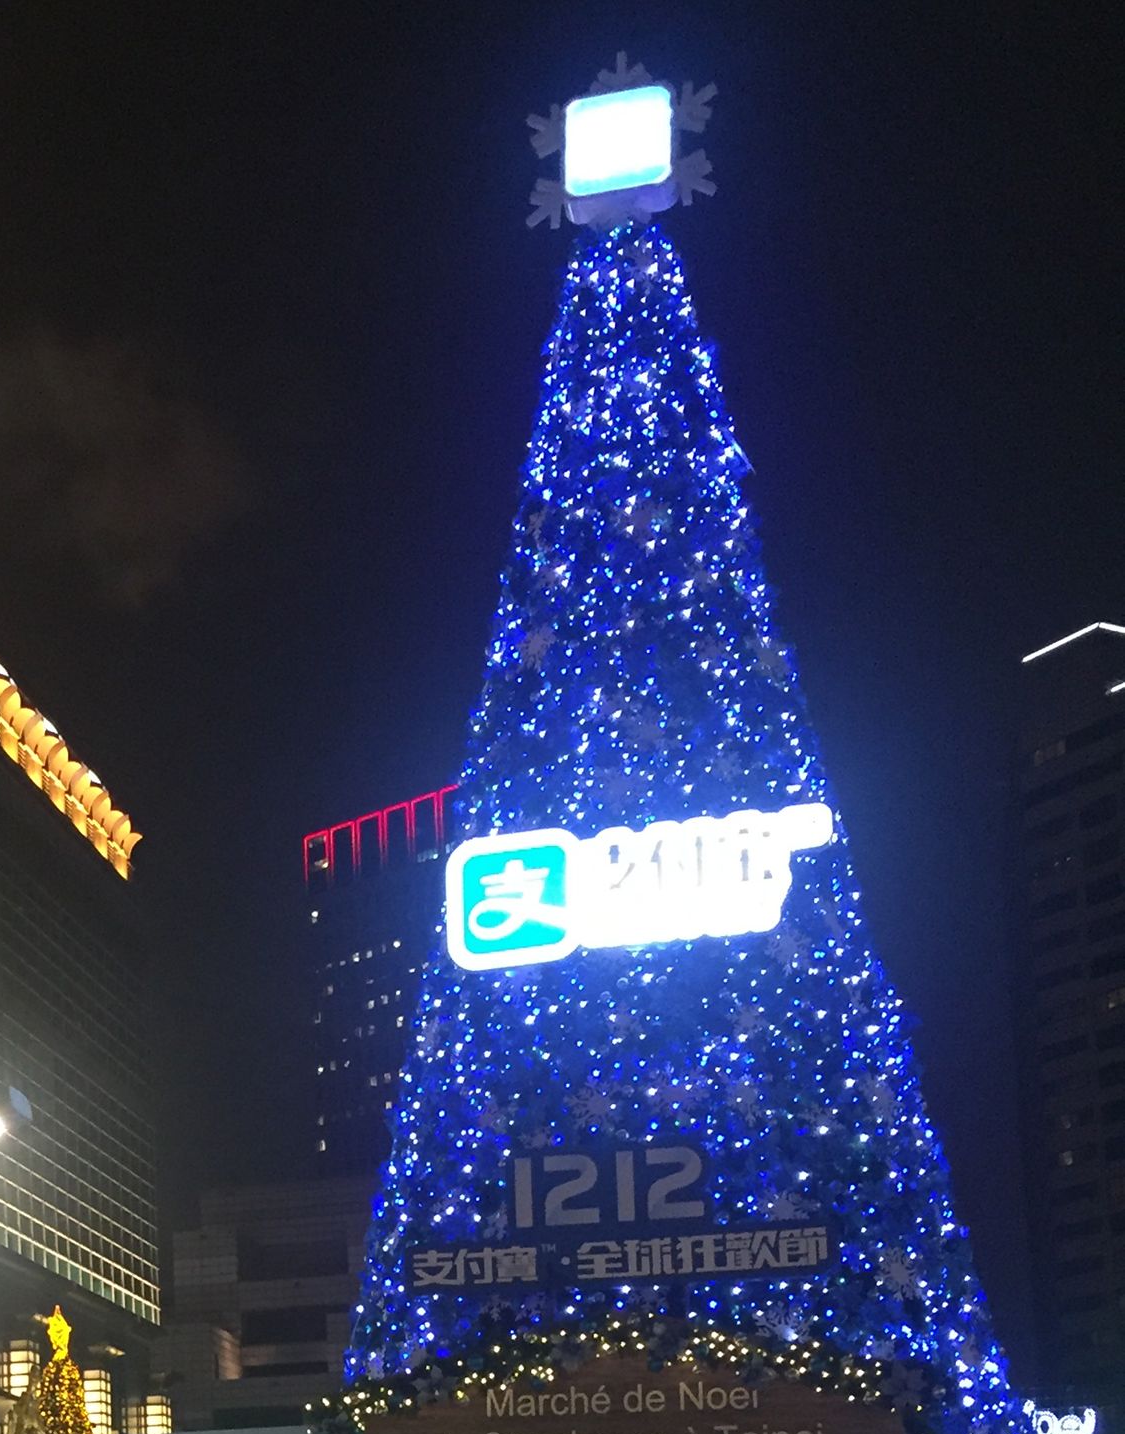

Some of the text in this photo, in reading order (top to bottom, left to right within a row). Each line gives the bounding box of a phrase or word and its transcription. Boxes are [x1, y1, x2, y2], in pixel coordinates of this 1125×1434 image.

[514, 1146, 705, 1228] 1212
[485, 1385, 611, 1417] Marché
[623, 1384, 666, 1413] de
